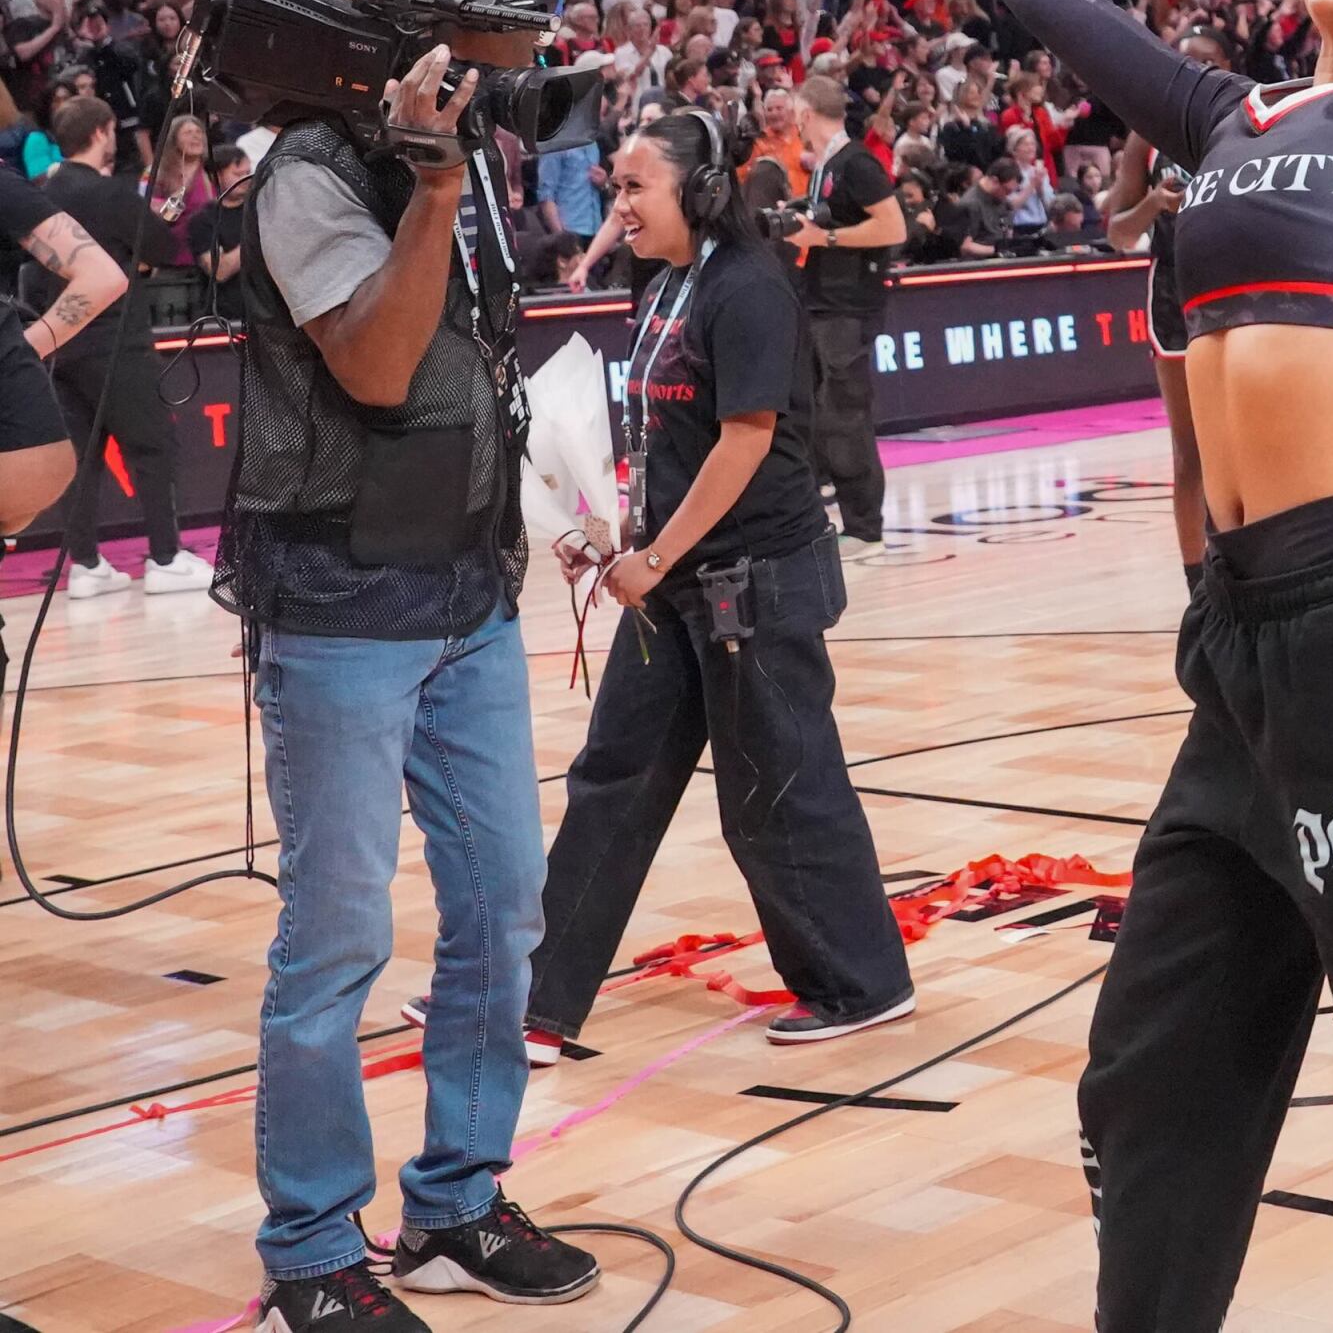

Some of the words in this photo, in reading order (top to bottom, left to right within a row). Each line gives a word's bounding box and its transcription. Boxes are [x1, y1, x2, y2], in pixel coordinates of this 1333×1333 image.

[349, 41, 378, 54] SONY
[1178, 168, 1225, 215] SE
[874, 331, 925, 373] RE
[944, 314, 1078, 365] WHERE
